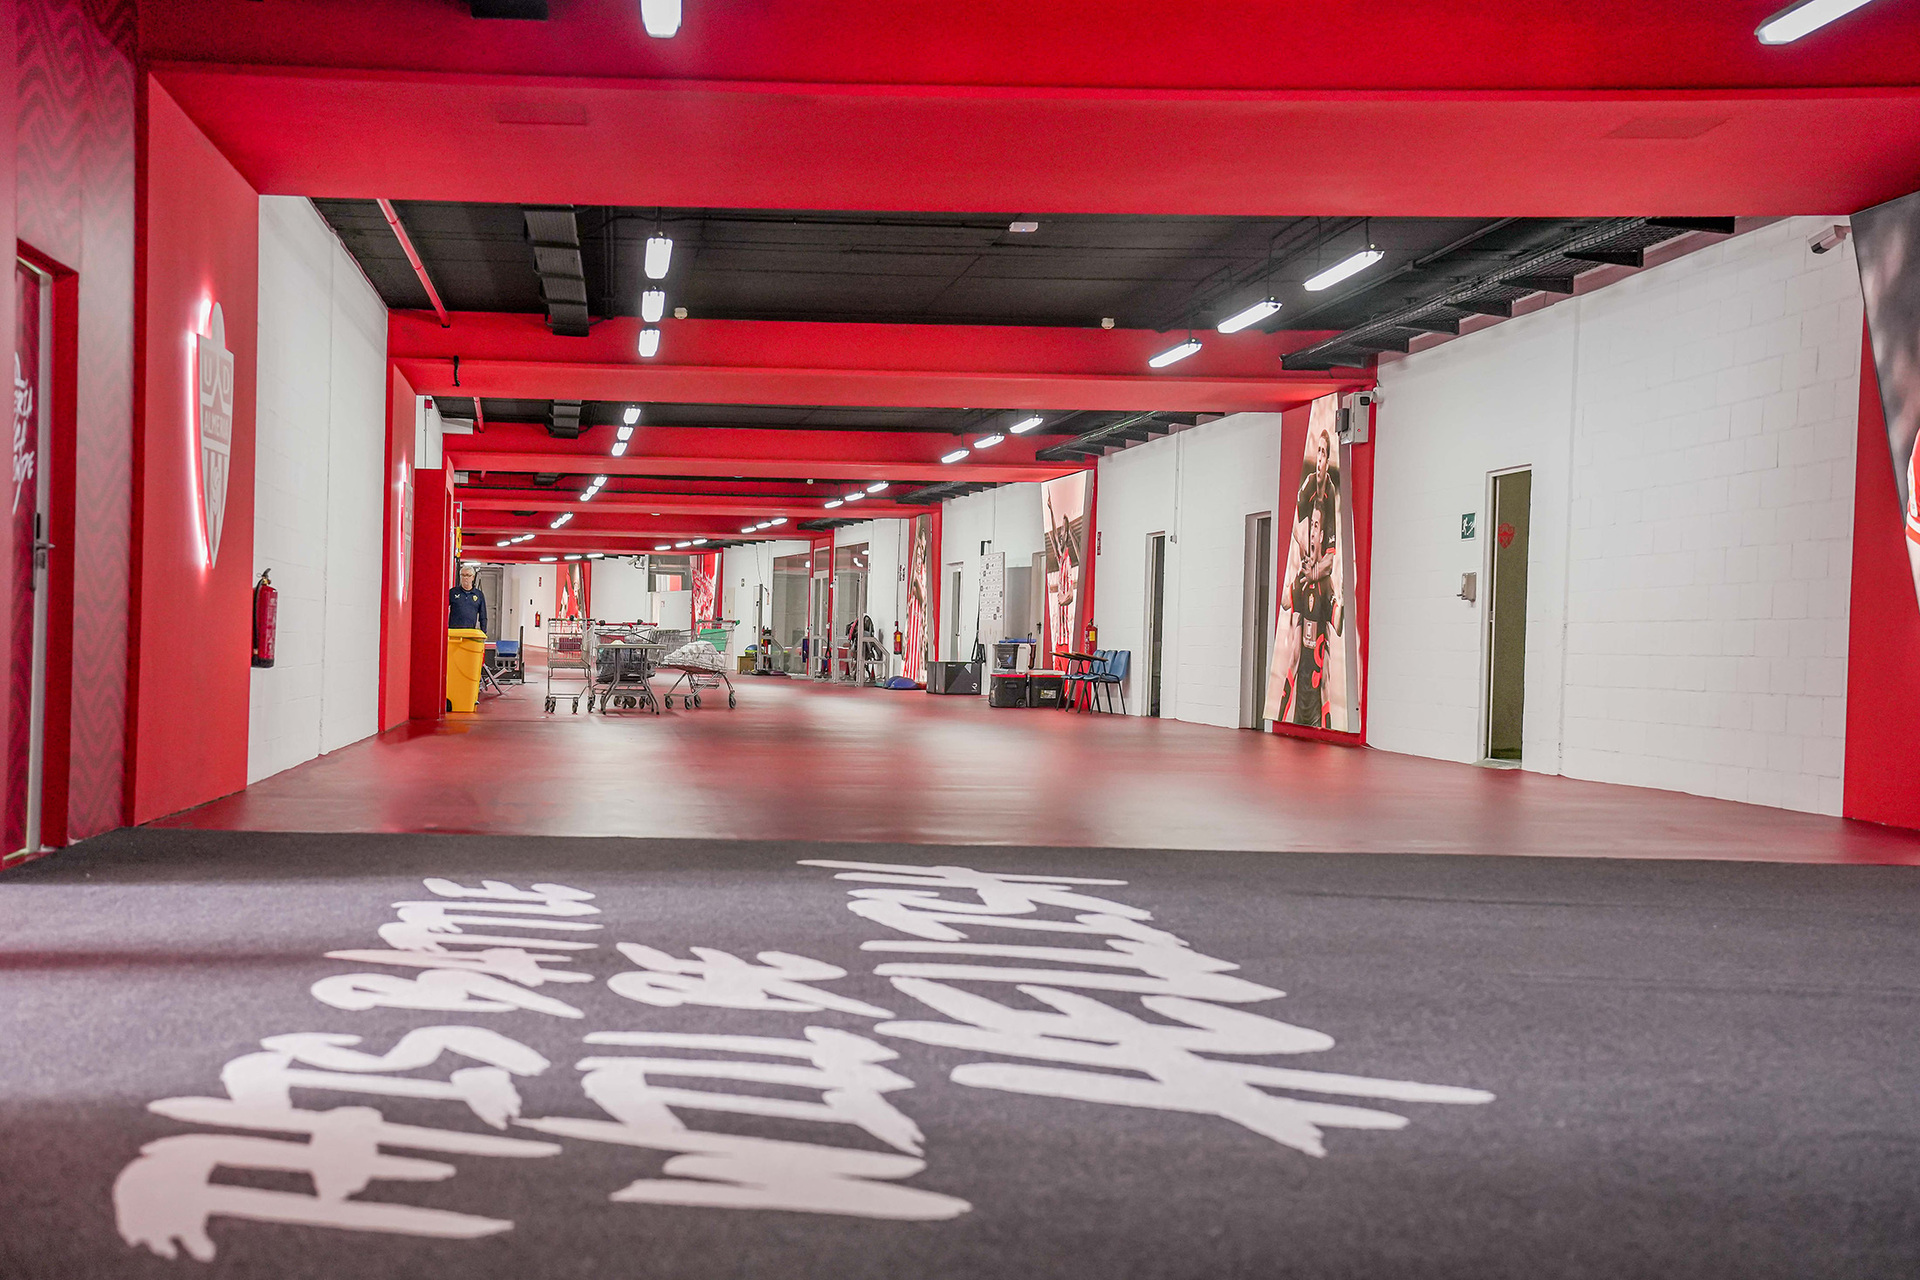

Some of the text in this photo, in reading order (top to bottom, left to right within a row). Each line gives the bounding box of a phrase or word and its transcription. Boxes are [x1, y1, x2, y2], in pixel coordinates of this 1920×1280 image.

[114, 877, 604, 1262] THIS BATTLE
[513, 941, 973, 1221] WILL BE
[797, 859, 1495, 1157] HELLISH
